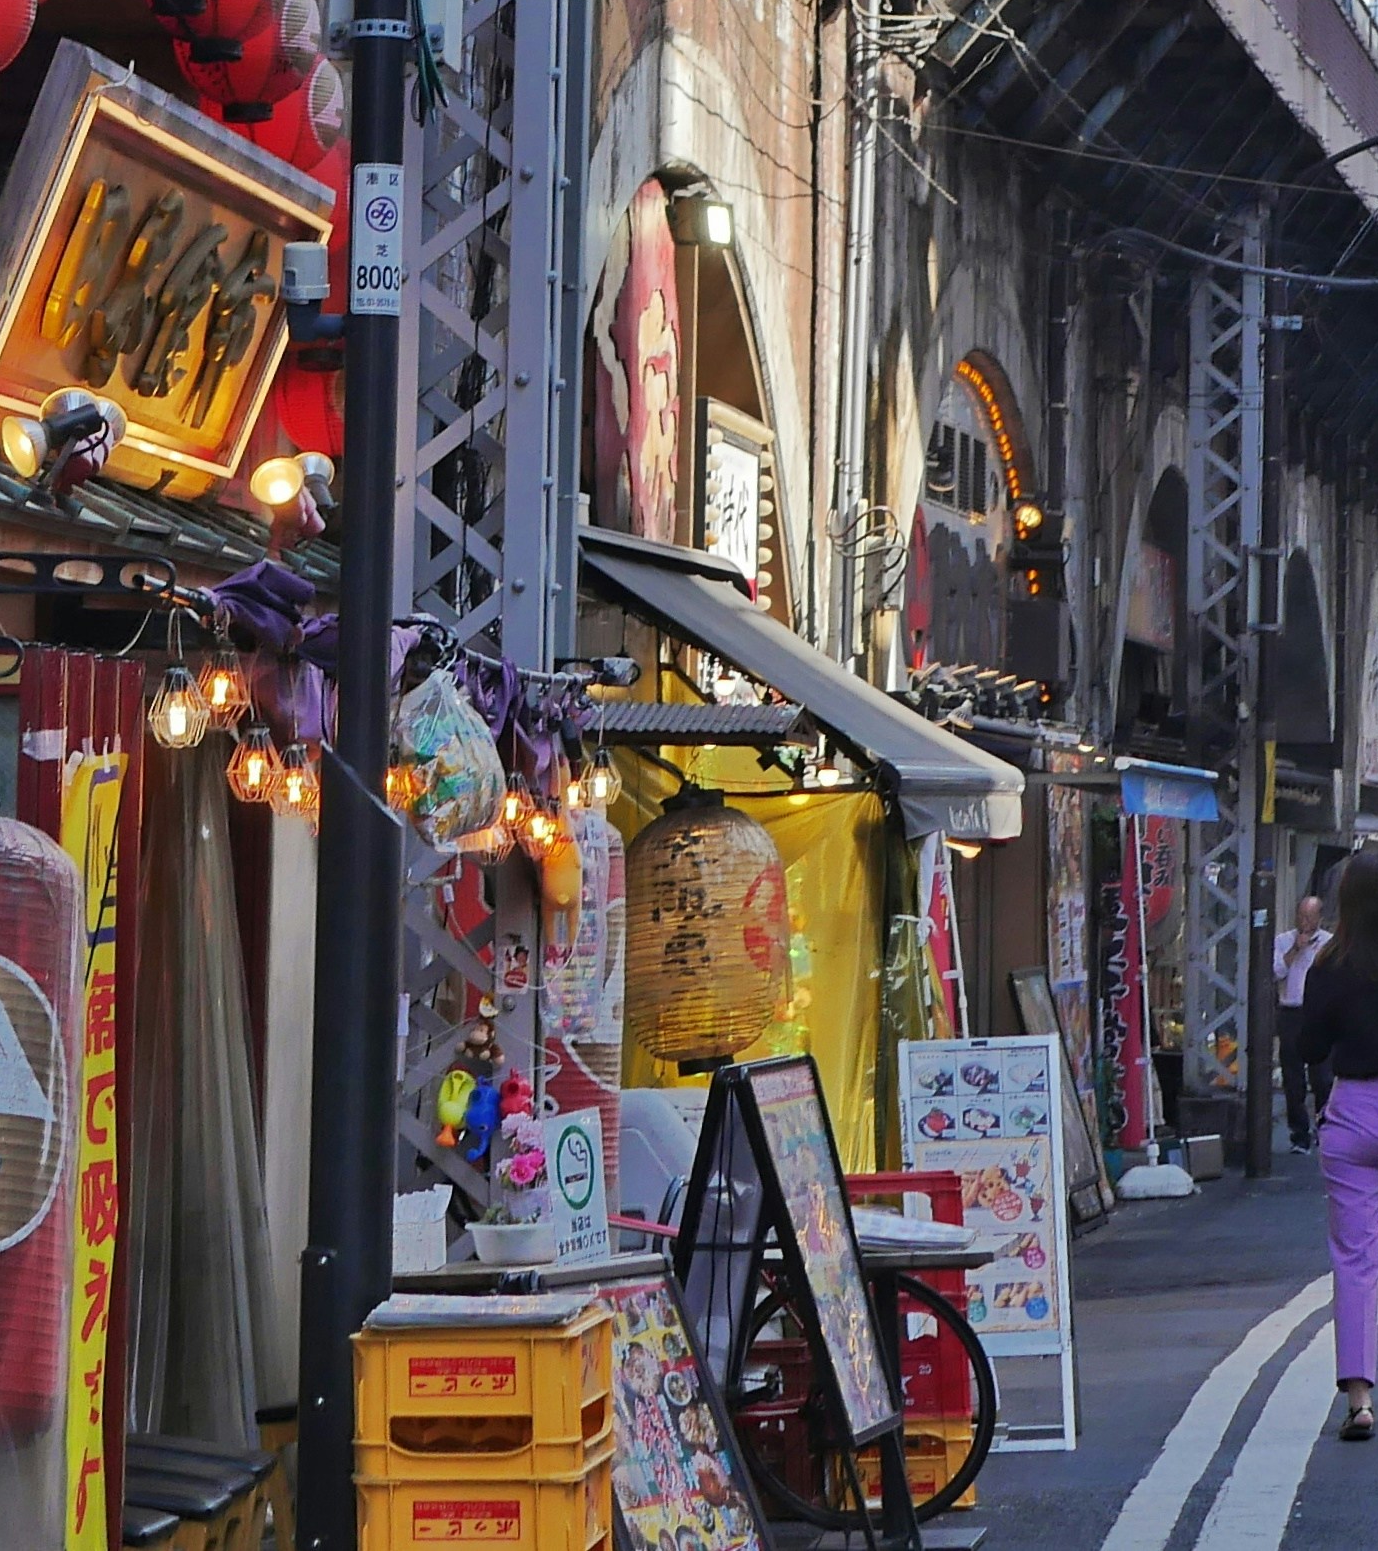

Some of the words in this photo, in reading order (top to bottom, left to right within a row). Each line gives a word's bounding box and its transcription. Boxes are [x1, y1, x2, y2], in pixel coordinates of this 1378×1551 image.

[366, 171, 399, 186] 港区
[375, 244, 389, 258] 芝
[356, 265, 400, 292] 8003
[414, 1375, 510, 1393] ホッピー
[418, 1519, 514, 1536] ホッピー
